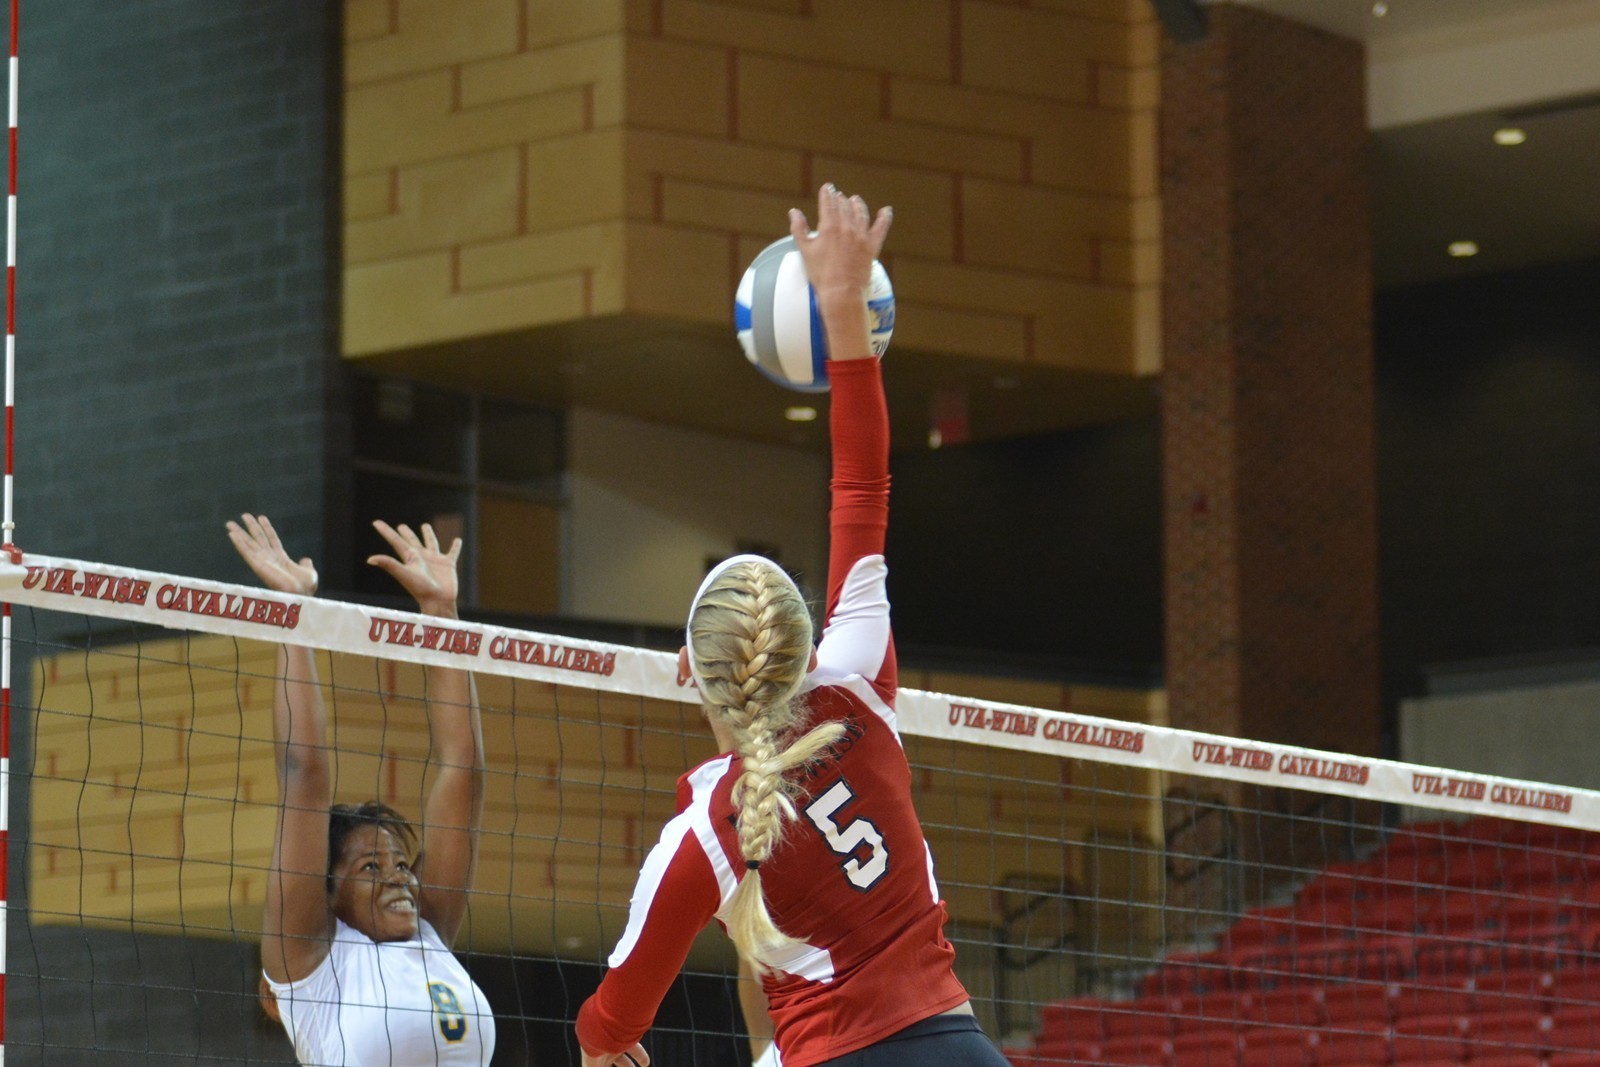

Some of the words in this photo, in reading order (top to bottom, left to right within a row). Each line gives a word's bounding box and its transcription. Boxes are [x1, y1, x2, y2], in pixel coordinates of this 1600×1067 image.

[22, 566, 151, 606] UVA-WISE
[156, 583, 302, 630] CAVALIERS
[369, 616, 483, 657] UVA-WISE
[489, 635, 617, 677] CAVALIERS
[948, 703, 1039, 737] UVA-WISE
[1043, 718, 1145, 754] CAVALIERS
[1192, 741, 1274, 772] UVA-WISE
[1278, 754, 1370, 786] CAVALIERS
[1412, 773, 1486, 801] UVA-WISE
[1490, 782, 1573, 814] CAVALIERS
[803, 776, 889, 894] 5
[427, 981, 469, 1044] 8
